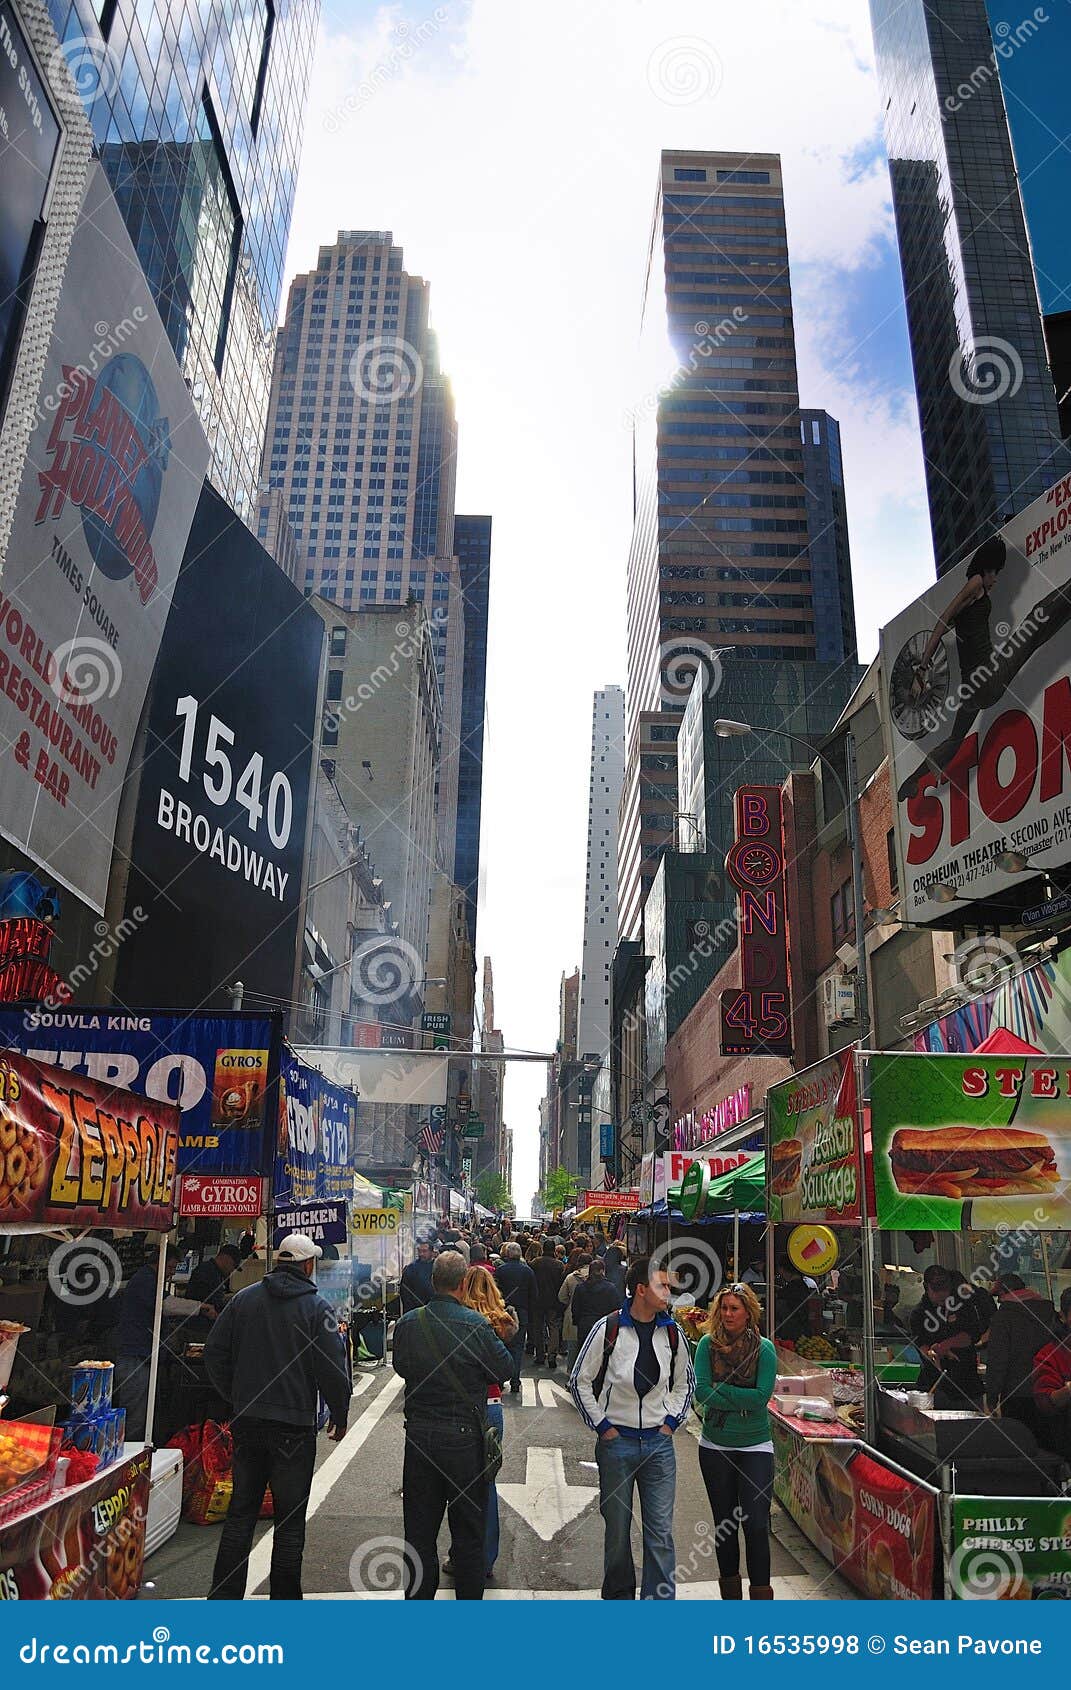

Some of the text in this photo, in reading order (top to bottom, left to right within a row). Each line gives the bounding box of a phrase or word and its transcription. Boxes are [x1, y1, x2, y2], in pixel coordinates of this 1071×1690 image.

[46, 365, 148, 487] PLANET
[35, 441, 158, 606] HOLLYWOOD
[51, 535, 120, 650] TIMES SQUARE
[59, 671, 118, 765] FAMOUS
[15, 730, 70, 809] & BAR
[176, 695, 293, 850] 1540
[157, 788, 289, 902] BROADWAY
[913, 859, 960, 893] ORPHEUM
[963, 836, 1008, 869] THEATRE
[1011, 818, 1049, 848] SECOND
[735, 794, 784, 988] BOND
[1027, 899, 1068, 921] Van Wagner
[30, 1012, 151, 1031] SOUVLA KING
[726, 992, 788, 1039] 45
[221, 1055, 263, 1068] GYROS
[962, 1067, 1071, 1099] STE
[40, 1079, 177, 1212] ZEPPOLE
[182, 1204, 201, 1212] LAMB
[201, 1204, 207, 1212] &
[208, 1203, 237, 1212] CHICKEN
[201, 1186, 257, 1203] GYROS
[801, 1164, 857, 1214] Sausages
[277, 1208, 338, 1228] CHICKEN
[353, 1213, 396, 1230] GYROS
[859, 1488, 912, 1539] CORN DOGS
[962, 1517, 1028, 1532] PHILLY
[962, 1536, 1036, 1552] CHEESE
